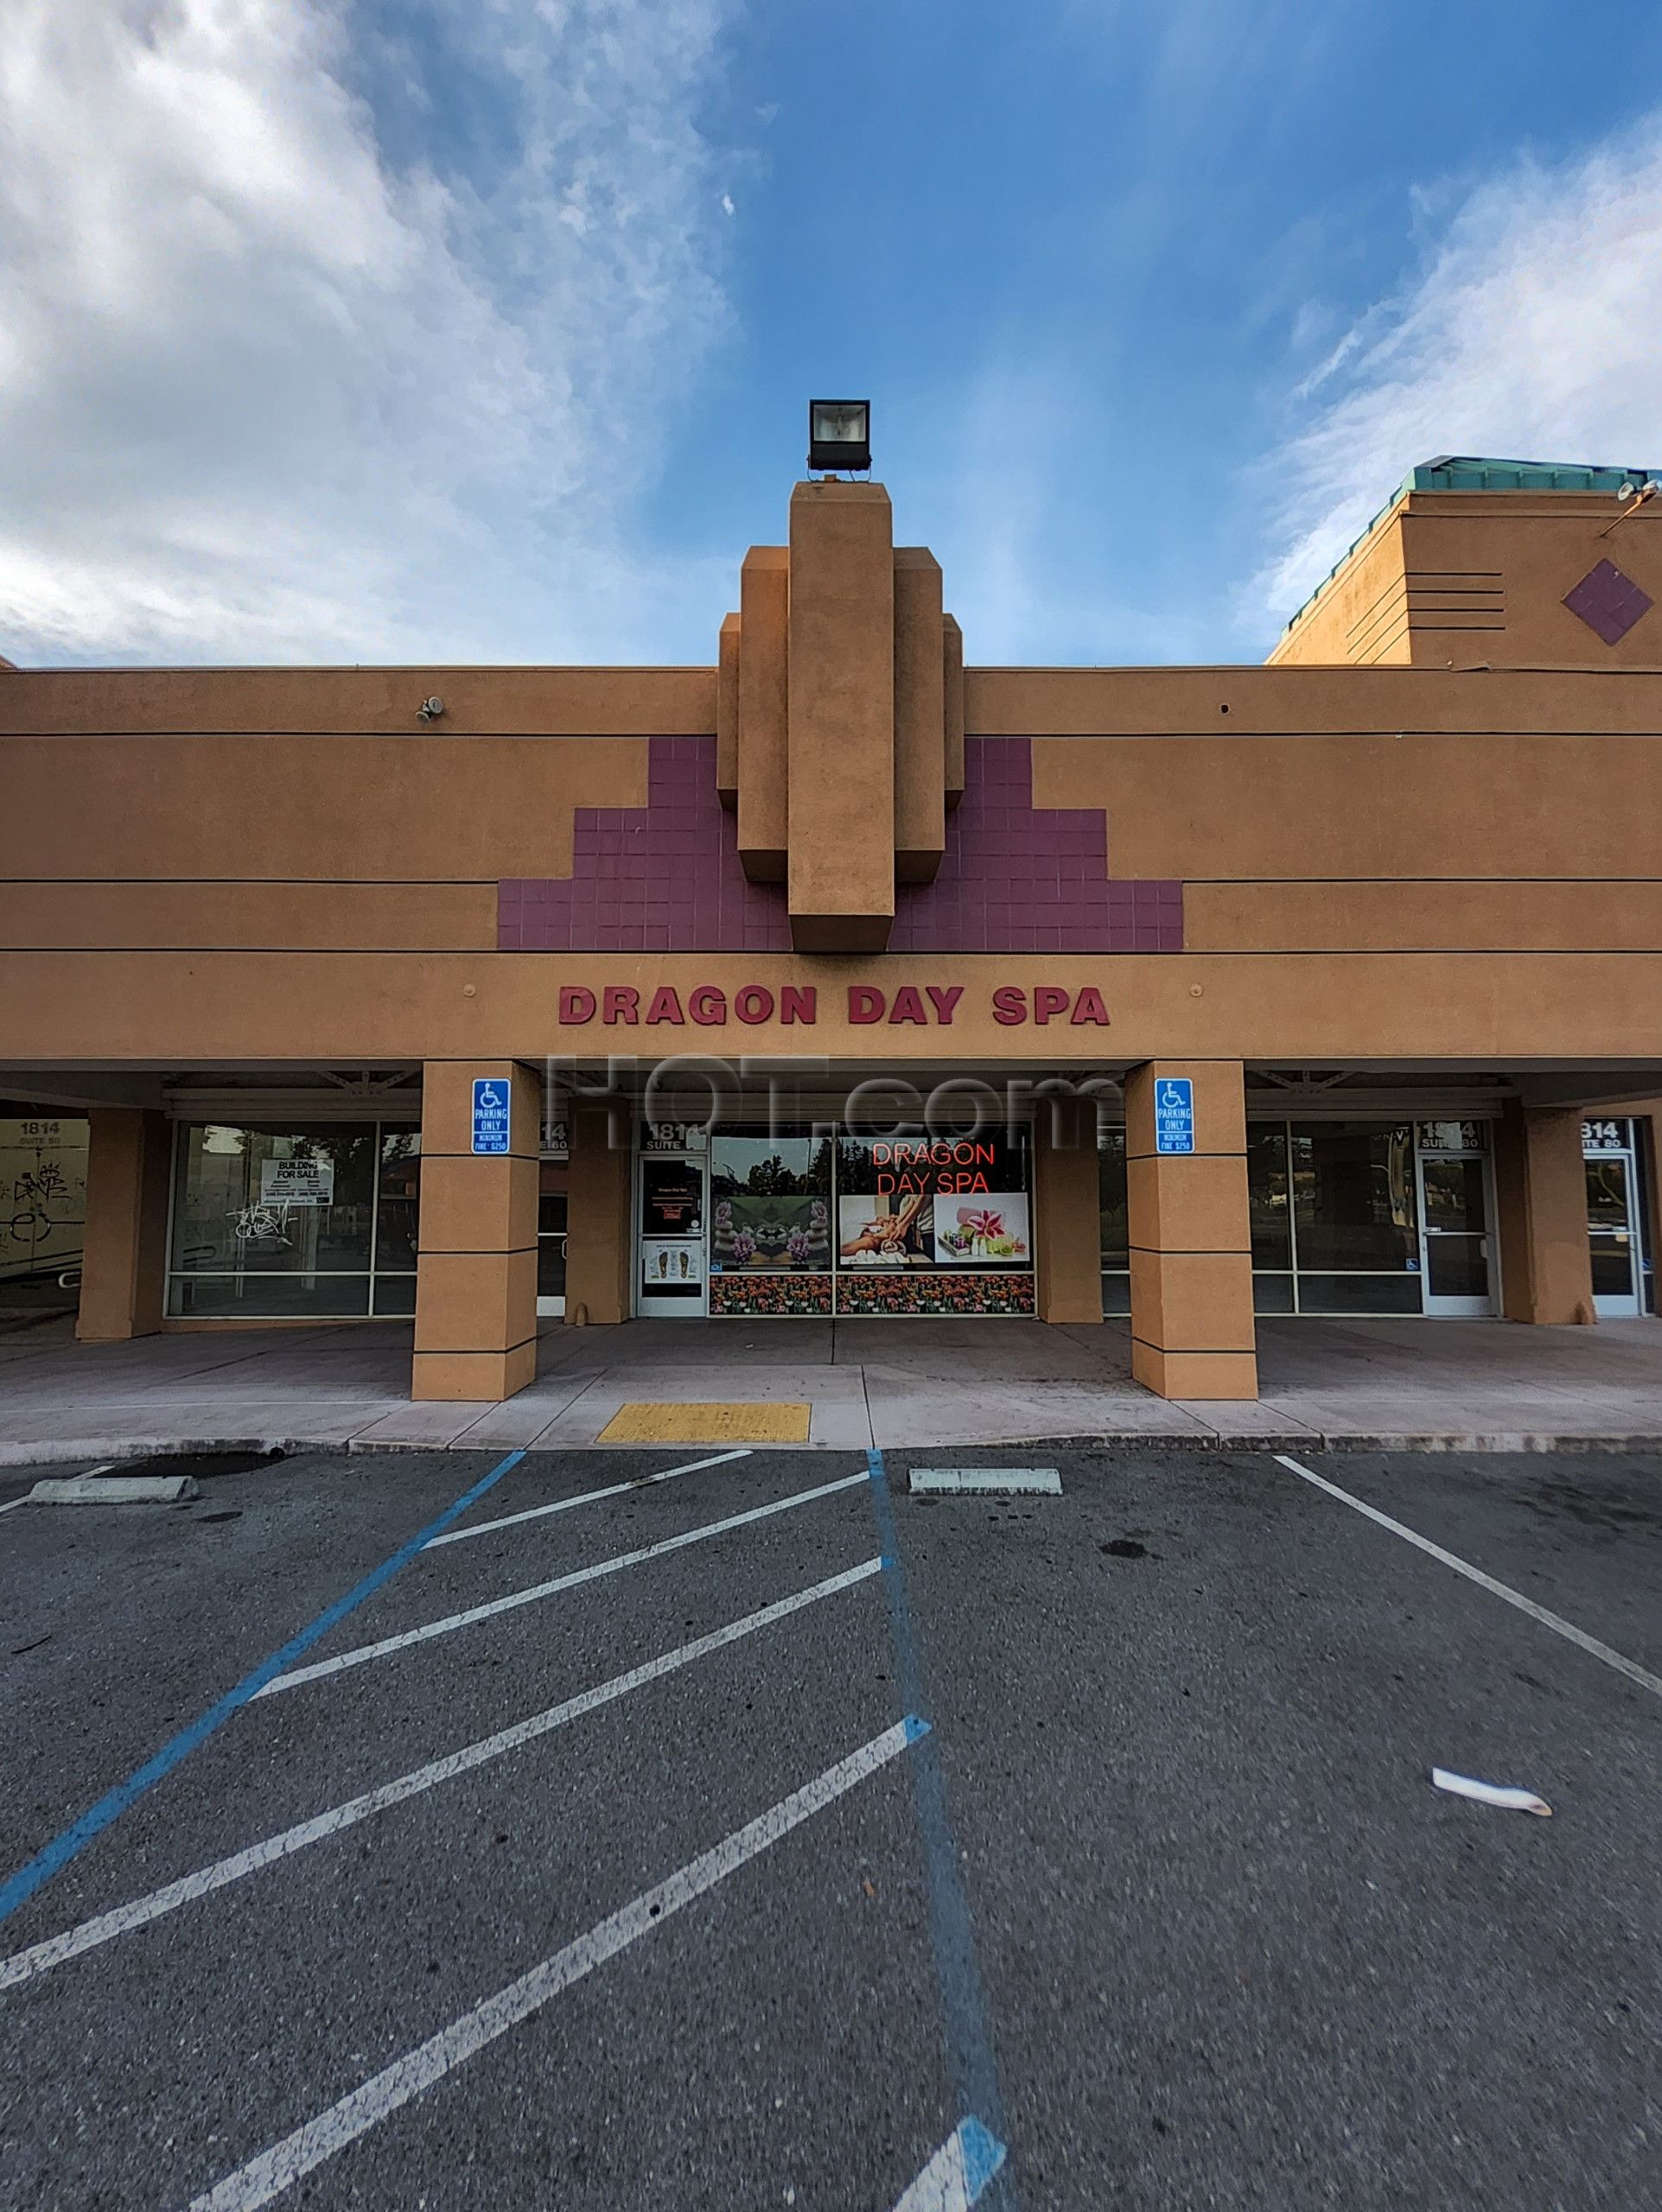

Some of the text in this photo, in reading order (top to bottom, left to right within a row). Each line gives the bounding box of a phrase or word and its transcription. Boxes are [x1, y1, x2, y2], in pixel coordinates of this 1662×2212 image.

[558, 985, 1111, 1026] DRAGON DAY SPA
[474, 1108, 507, 1119] PARKING
[1158, 1108, 1191, 1119] PARKING
[20, 1122, 60, 1135] 1814
[481, 1121, 501, 1131] ONLY
[1165, 1119, 1184, 1130] ONLY
[1423, 1122, 1476, 1138] 184
[541, 1123, 566, 1140] 14
[1581, 1122, 1619, 1139] 814
[551, 1141, 567, 1149] 60
[646, 1141, 681, 1150] SUITE
[1604, 1139, 1621, 1147] 80
[873, 1142, 994, 1165] DRAGON
[278, 1161, 318, 1170] BUILDING
[277, 1170, 319, 1179] FOR SALE
[878, 1172, 989, 1195] DAY SPA
